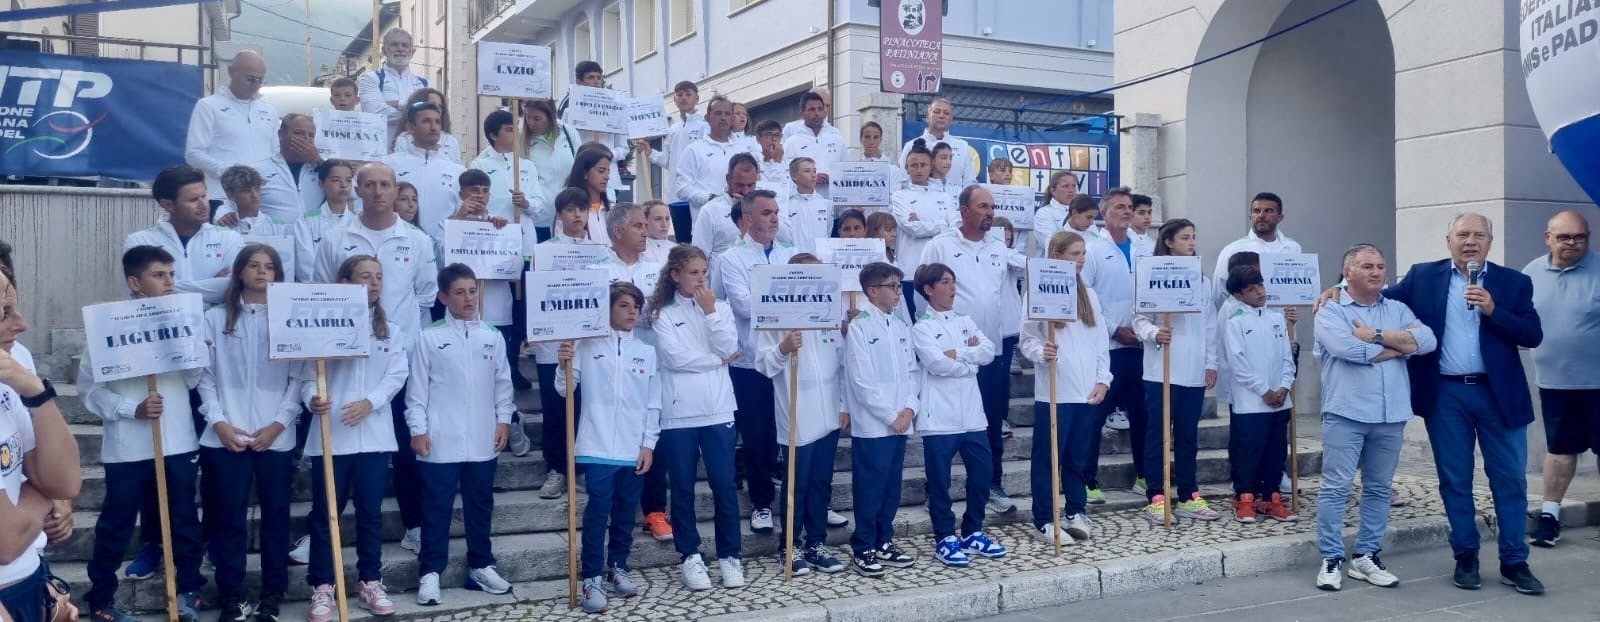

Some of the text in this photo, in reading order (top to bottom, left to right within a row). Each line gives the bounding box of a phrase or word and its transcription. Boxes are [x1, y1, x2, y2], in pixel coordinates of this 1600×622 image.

[1531, 0, 1600, 41] ITALIA
[883, 37, 941, 50] PINACOTECA
[886, 48, 939, 61] PATINIANA
[496, 64, 535, 76] LAZIO
[629, 111, 662, 121] MONTE
[321, 128, 379, 141] TOSCANA
[832, 180, 886, 188] SARDEGNA
[993, 204, 1026, 212] OLZANO
[450, 248, 519, 257] EMILIA ROMAGNA
[1149, 279, 1191, 289] PUGLIA
[1270, 277, 1313, 285] CAMPANIA
[1038, 283, 1070, 295] SICILIA
[760, 294, 833, 303] BASILICATA
[540, 297, 600, 312] UMBRIA
[285, 318, 355, 328] CALABRIA
[104, 325, 194, 348] LIGURIA
